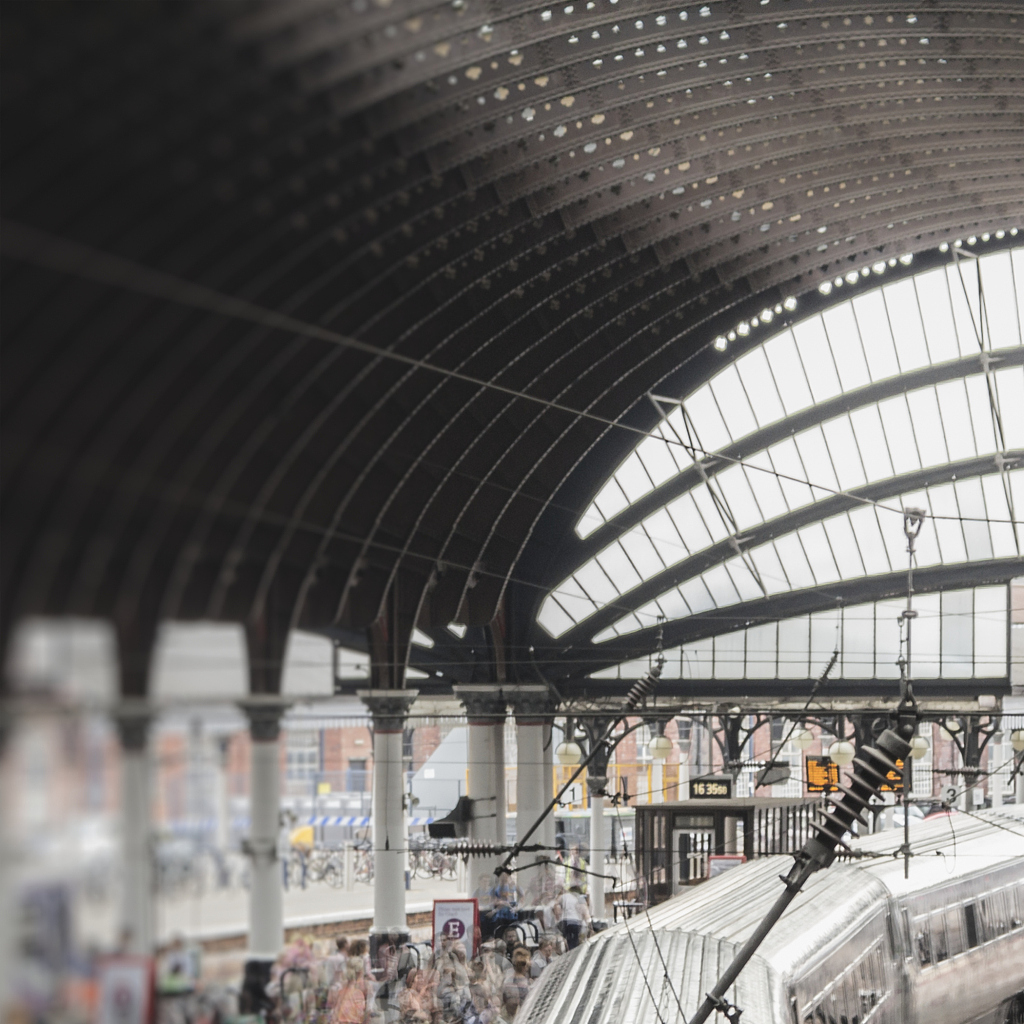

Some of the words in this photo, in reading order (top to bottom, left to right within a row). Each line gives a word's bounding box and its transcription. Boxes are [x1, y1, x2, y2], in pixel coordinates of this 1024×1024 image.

[570, 787, 575, 801] 1
[693, 782, 705, 795] 16
[946, 788, 957, 803] 3
[447, 921, 460, 938] E
